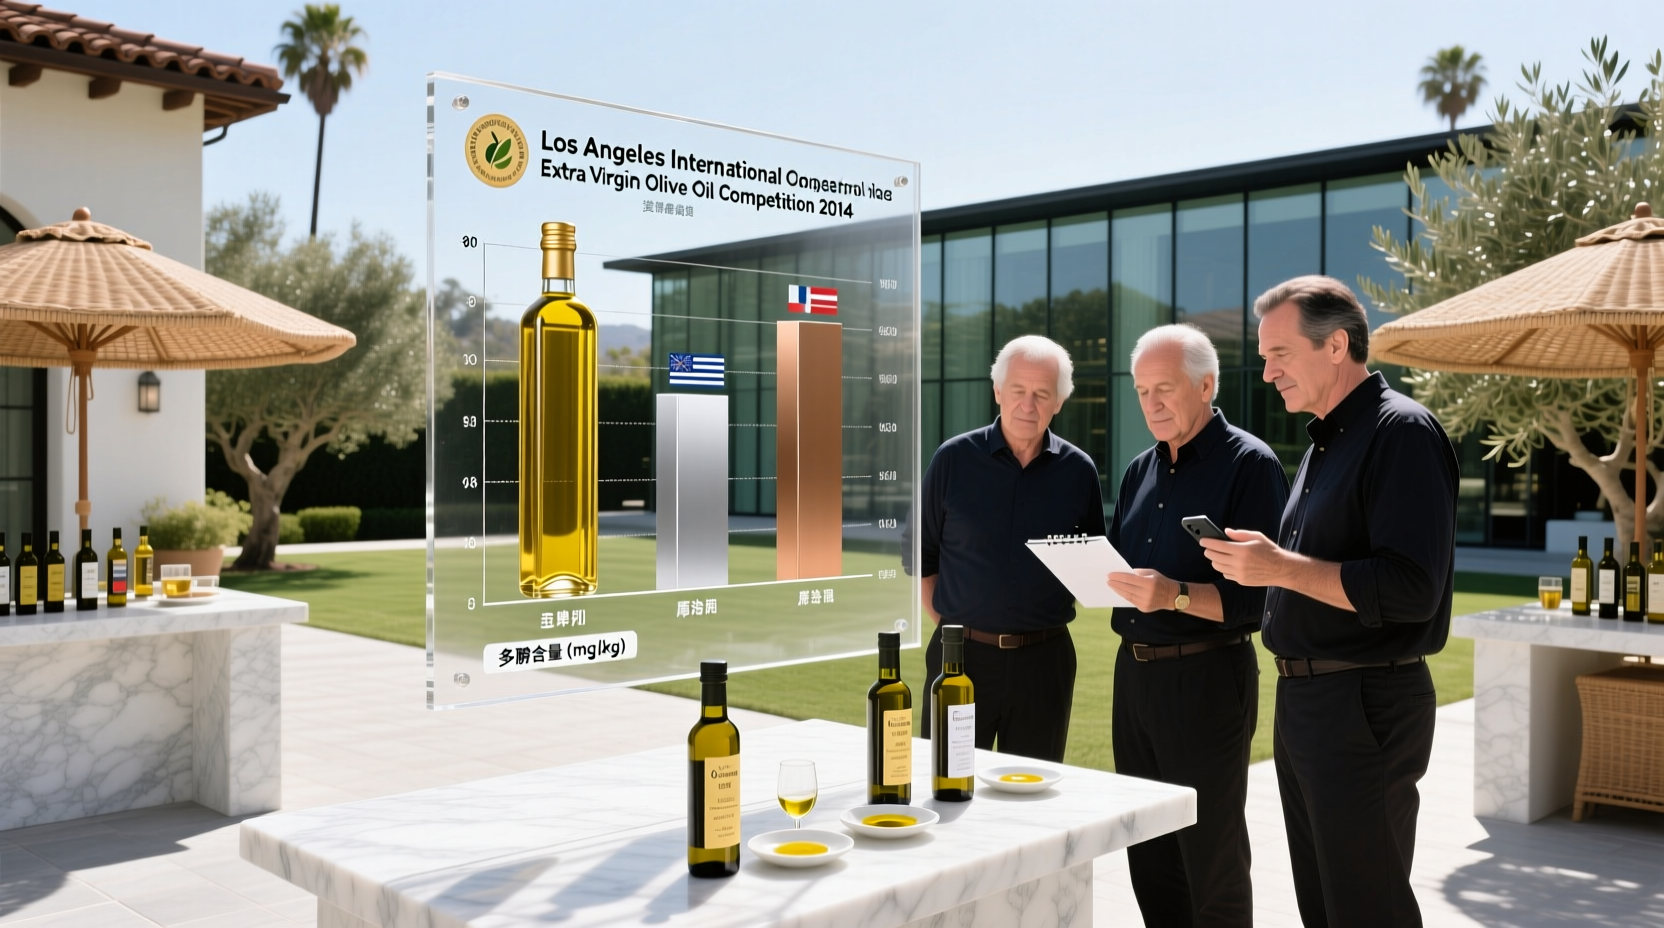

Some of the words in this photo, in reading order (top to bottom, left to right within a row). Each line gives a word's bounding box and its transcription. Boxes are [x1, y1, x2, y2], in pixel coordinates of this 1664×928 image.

[541, 130, 578, 154] Los
[583, 136, 665, 166] Angeles
[671, 149, 782, 185] International
[541, 158, 586, 183] Extra
[589, 165, 640, 192] Virgin
[645, 173, 688, 196] Olive
[692, 180, 714, 199] Oil
[718, 184, 815, 211] Competition
[819, 198, 854, 219] 2014
